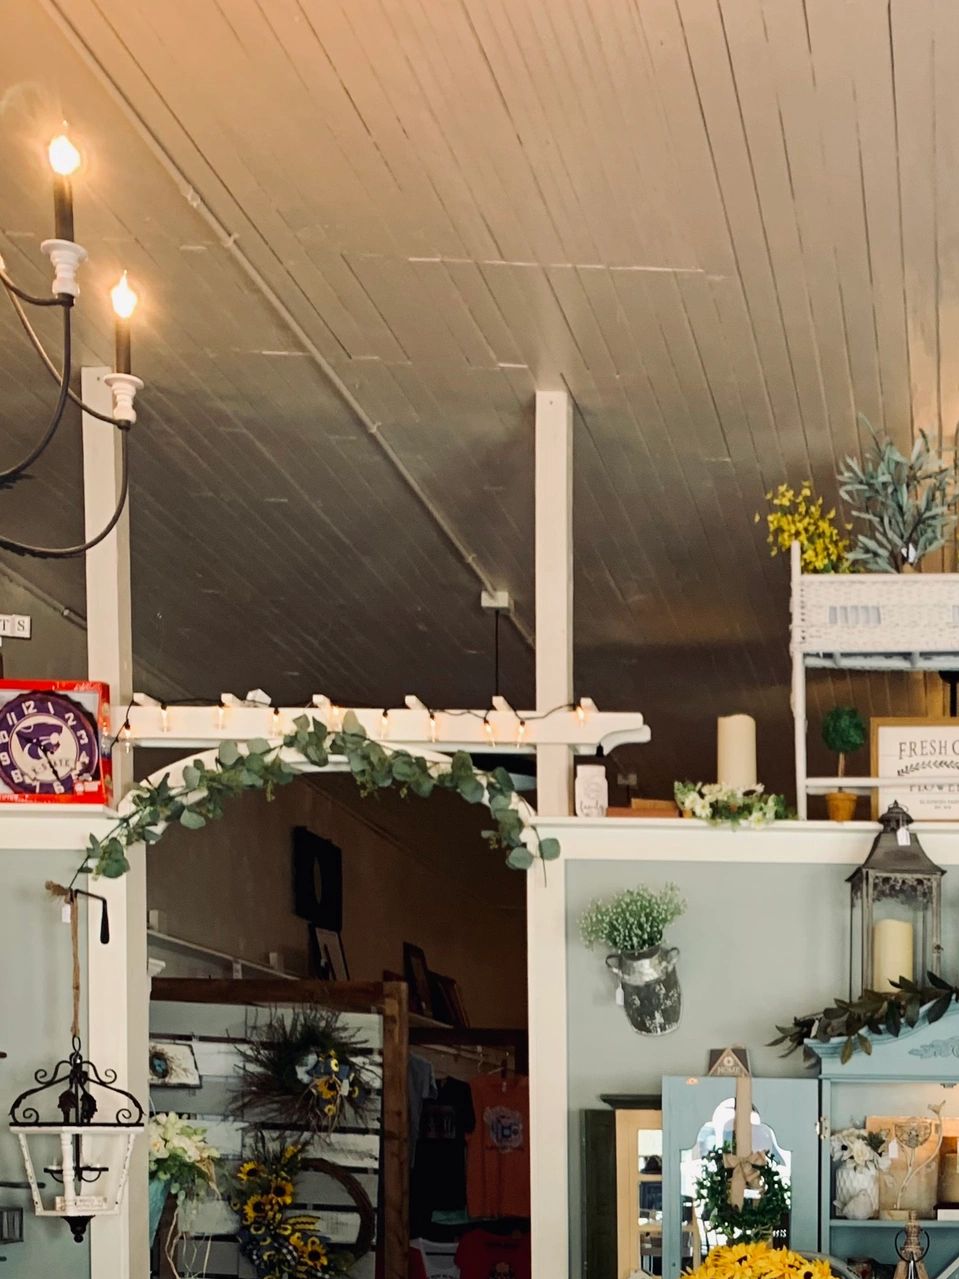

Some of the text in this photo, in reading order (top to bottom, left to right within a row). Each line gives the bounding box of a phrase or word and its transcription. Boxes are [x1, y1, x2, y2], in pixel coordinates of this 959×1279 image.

[22, 700, 37, 715] 12
[47, 701, 55, 714] 1
[6, 711, 18, 726] 11
[64, 712, 77, 726] 2
[76, 729, 89, 745] 3
[898, 740, 948, 760] FRESH
[11, 768, 24, 784] 8
